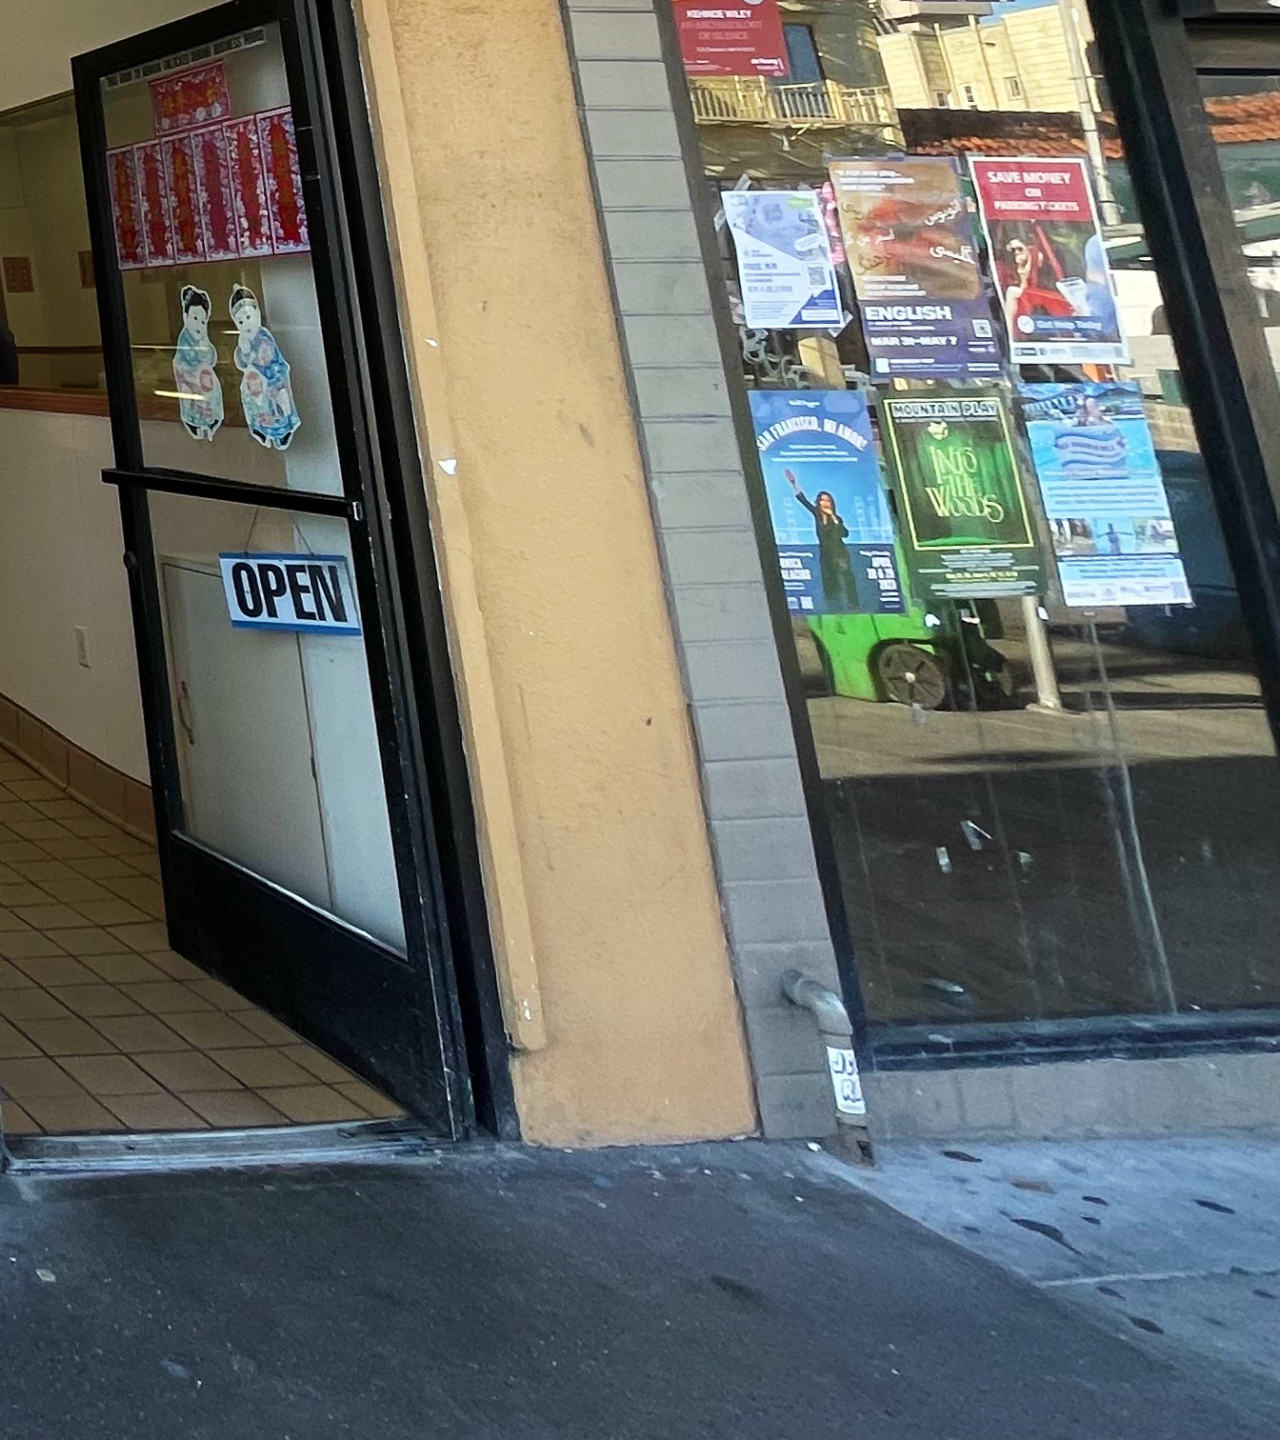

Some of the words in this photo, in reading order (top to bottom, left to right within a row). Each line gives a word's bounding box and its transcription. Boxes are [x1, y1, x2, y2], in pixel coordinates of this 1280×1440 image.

[987, 171, 1022, 184] SAVE
[864, 305, 953, 321] ENGLISH
[891, 402, 961, 417] MOUNTAIN
[962, 401, 999, 417] PLAY
[229, 559, 349, 624] OPEN
